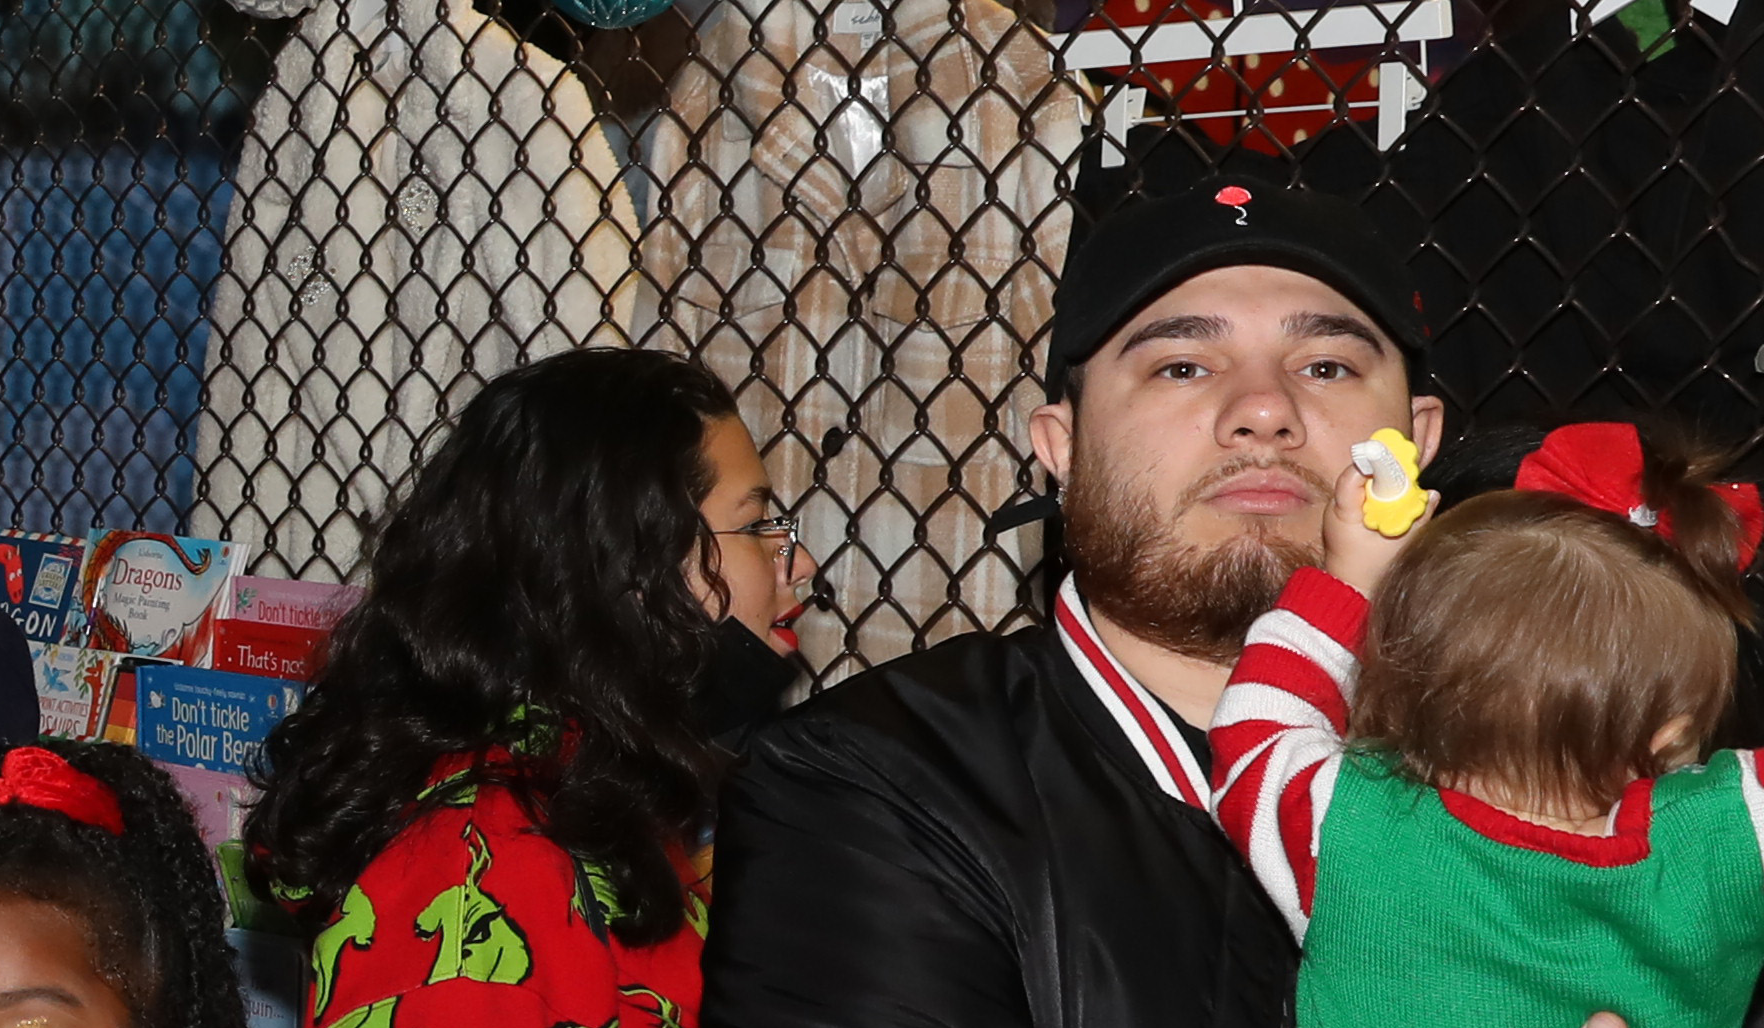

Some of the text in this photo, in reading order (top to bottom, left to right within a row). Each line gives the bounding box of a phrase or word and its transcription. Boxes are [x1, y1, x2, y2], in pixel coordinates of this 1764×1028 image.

[112, 558, 183, 594] Dragons
[258, 600, 286, 623] Don't
[237, 644, 278, 671] That's
[172, 697, 250, 732] Don't tickle
[156, 724, 174, 746] the
[176, 725, 218, 761] Polar
